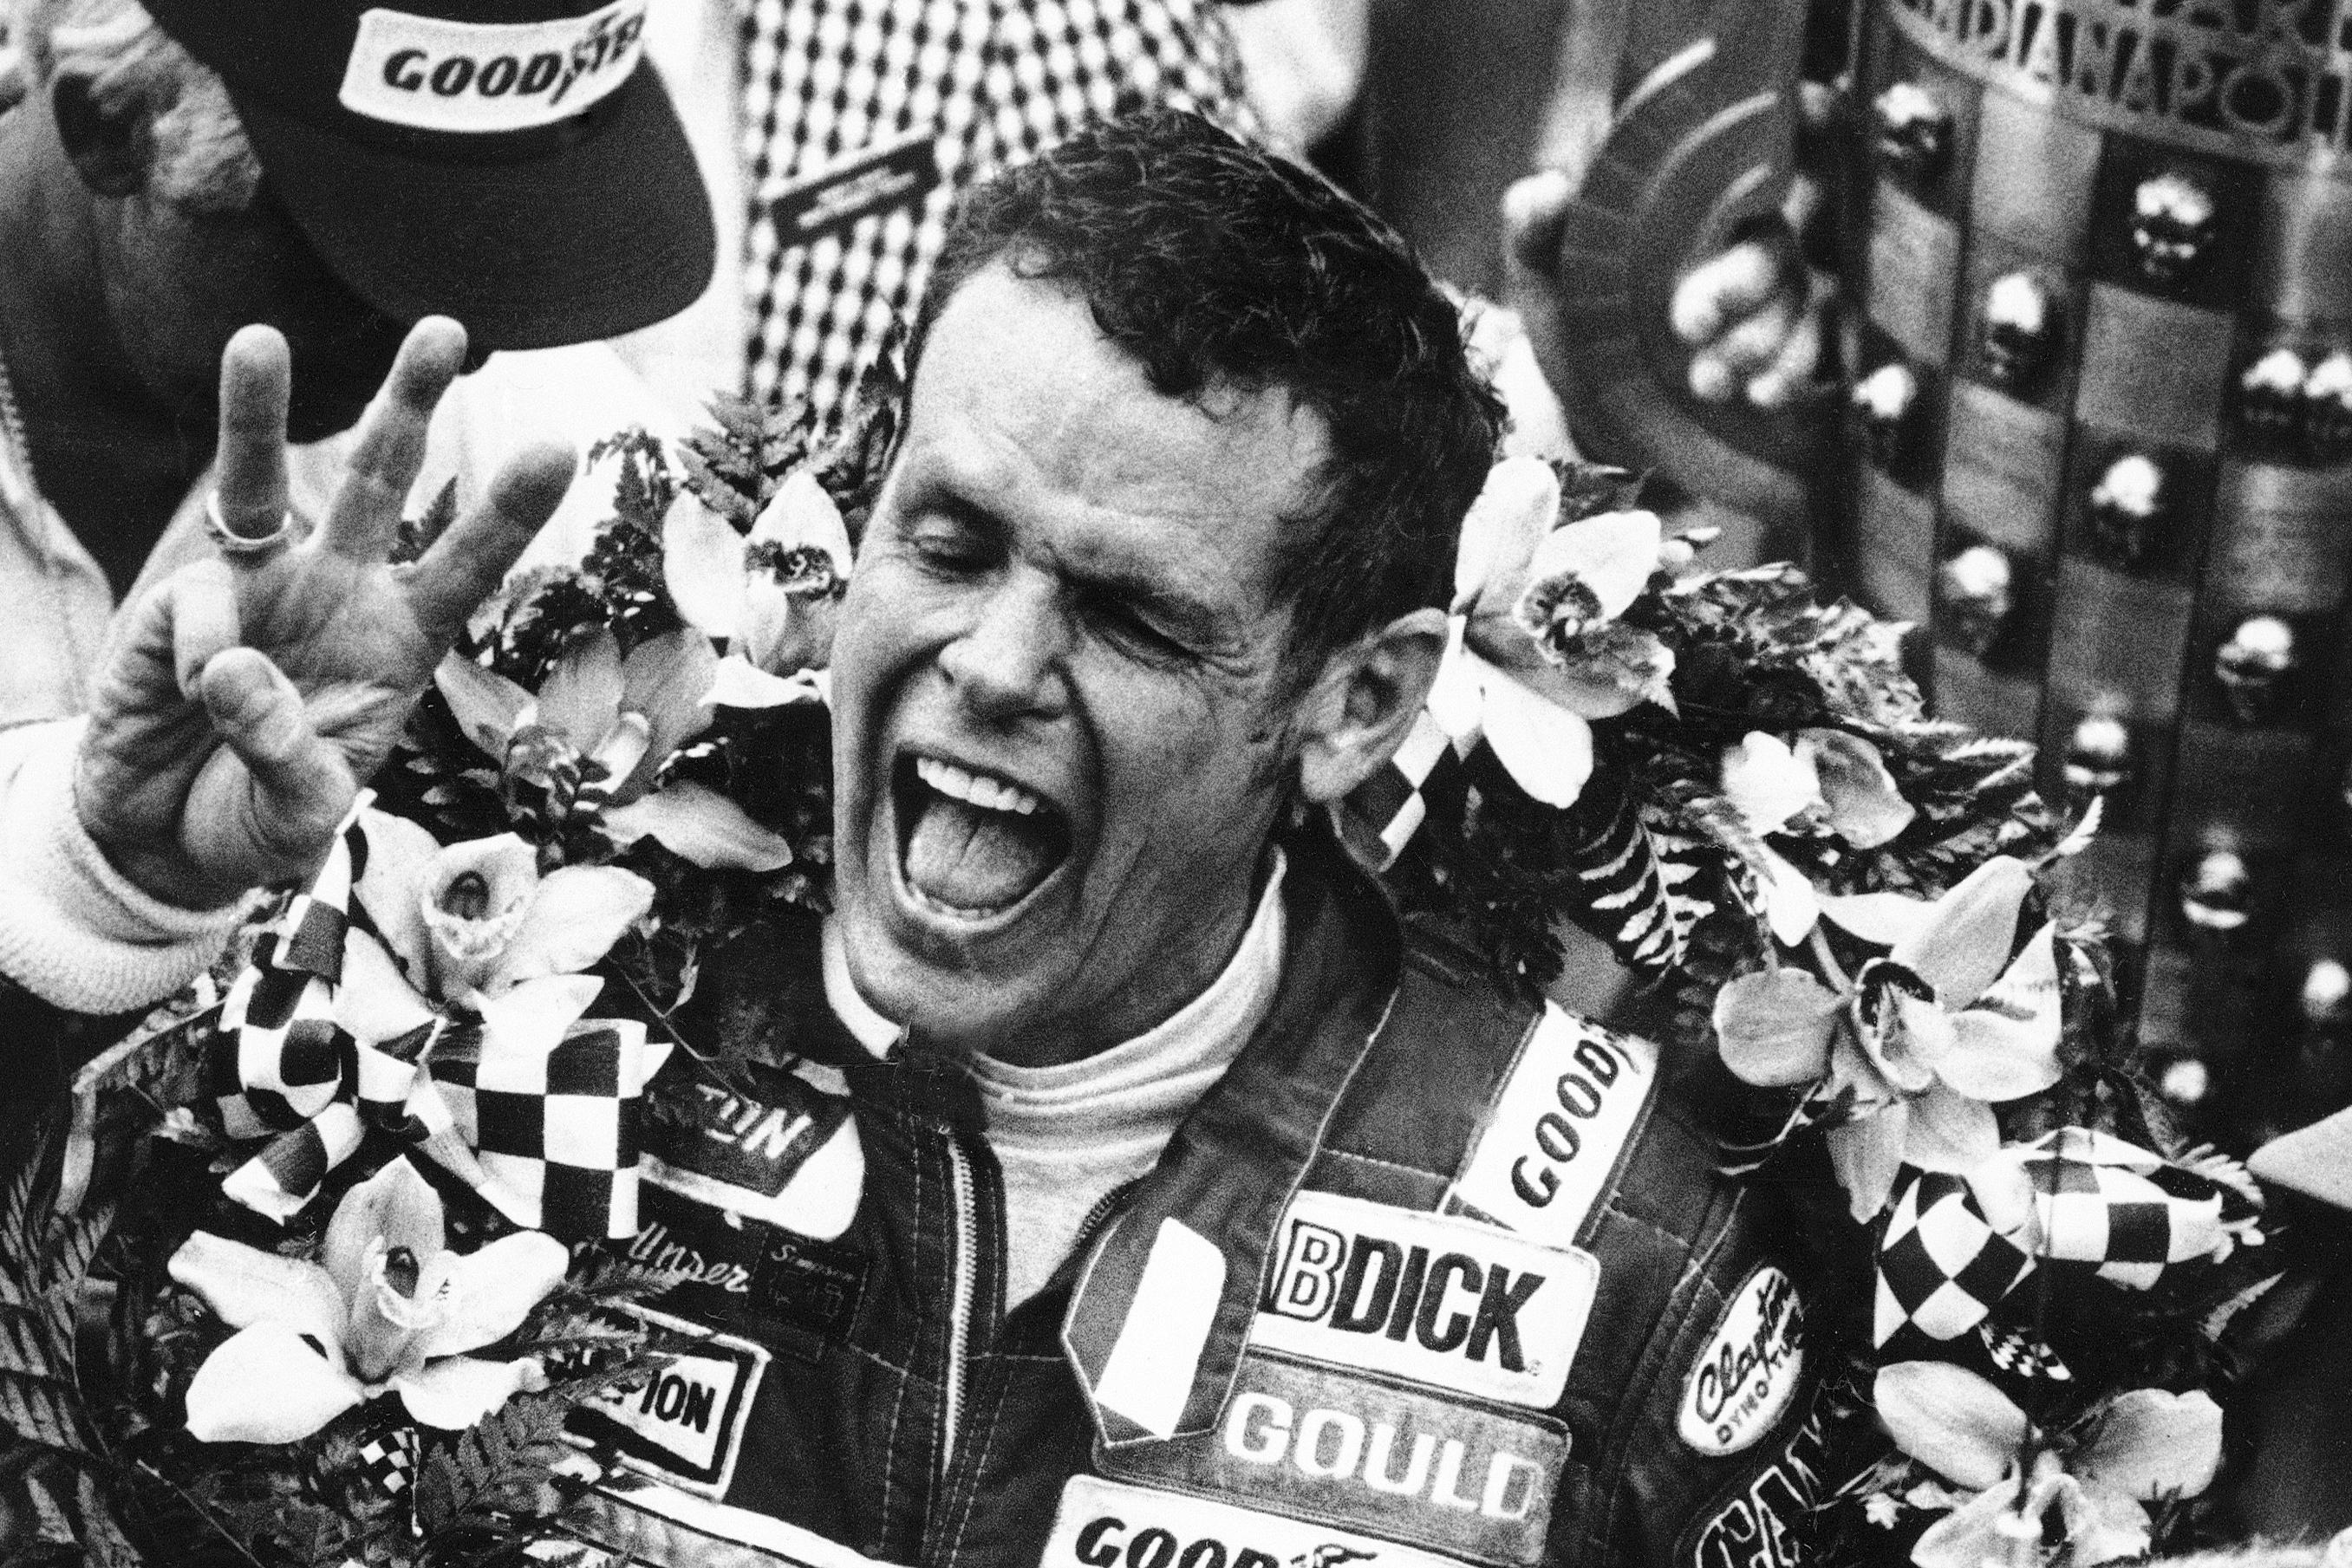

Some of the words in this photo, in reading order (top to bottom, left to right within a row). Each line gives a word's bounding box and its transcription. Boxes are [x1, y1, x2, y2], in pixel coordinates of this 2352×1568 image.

[628, 1220, 749, 1292] Unser
[1257, 1218, 1547, 1373] BDICK
[1225, 1391, 1544, 1520] GOULD
